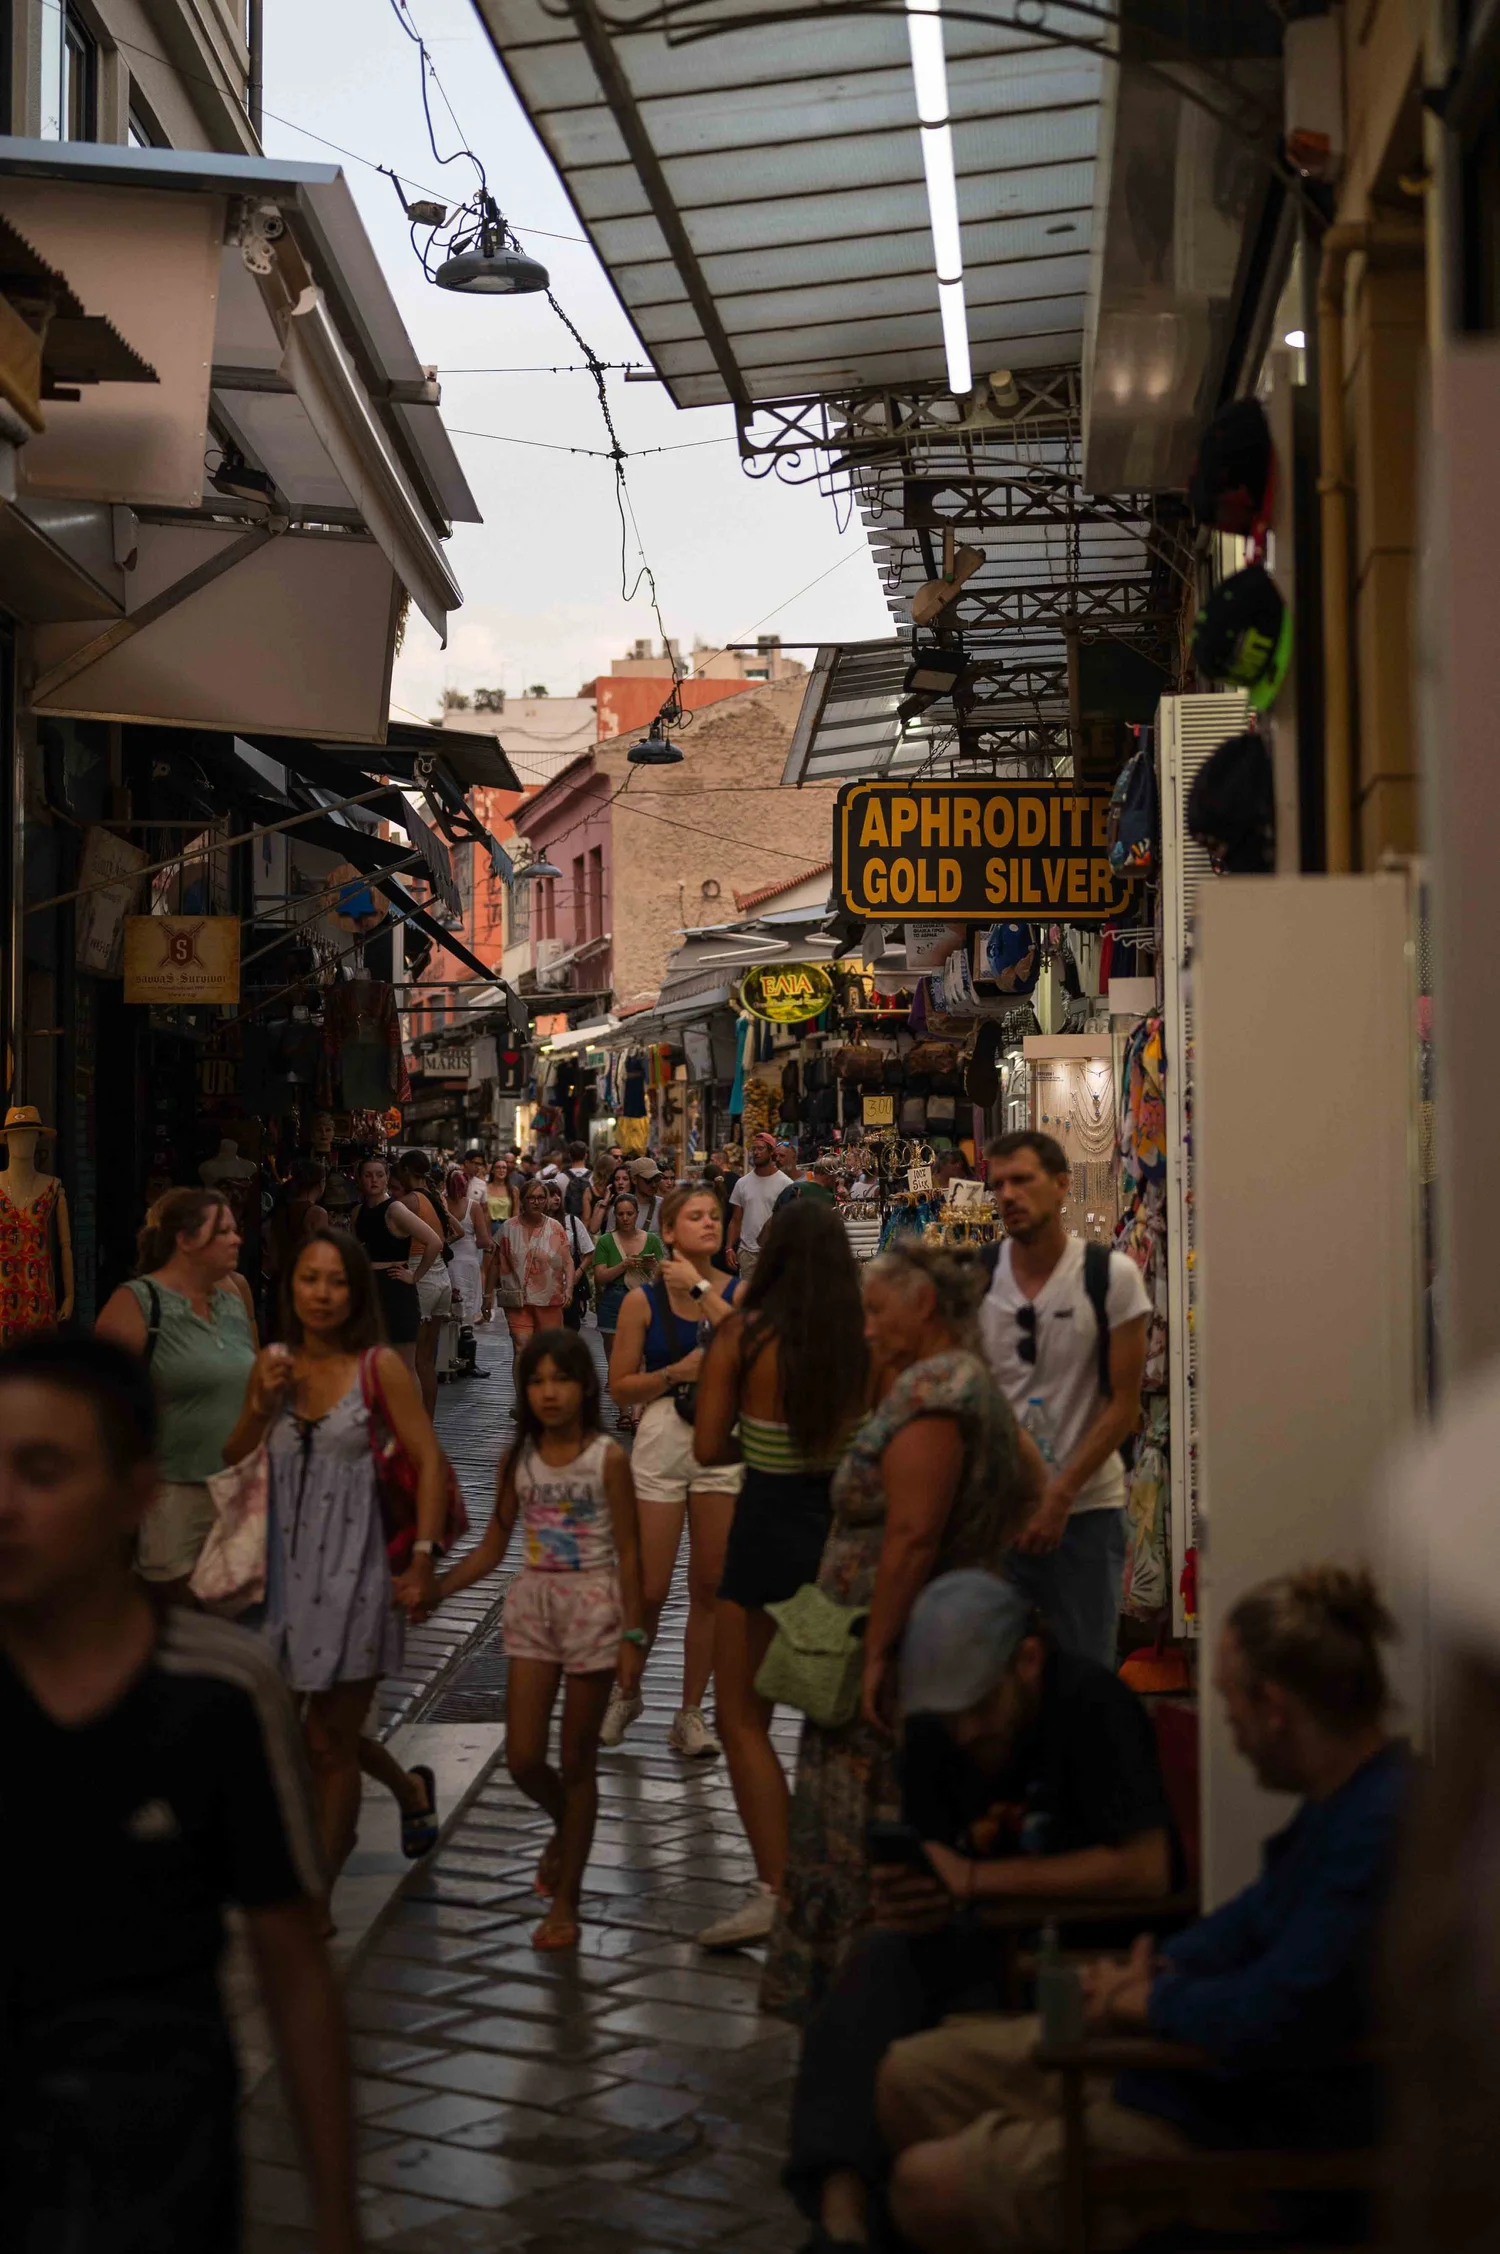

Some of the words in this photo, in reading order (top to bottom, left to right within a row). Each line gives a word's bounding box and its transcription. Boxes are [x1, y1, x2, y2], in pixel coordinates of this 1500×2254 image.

[859, 796, 1109, 848] APHRODITE
[862, 857, 963, 904] GOLD
[984, 857, 1115, 904] SILVER
[425, 1057, 470, 1070] MARIS
